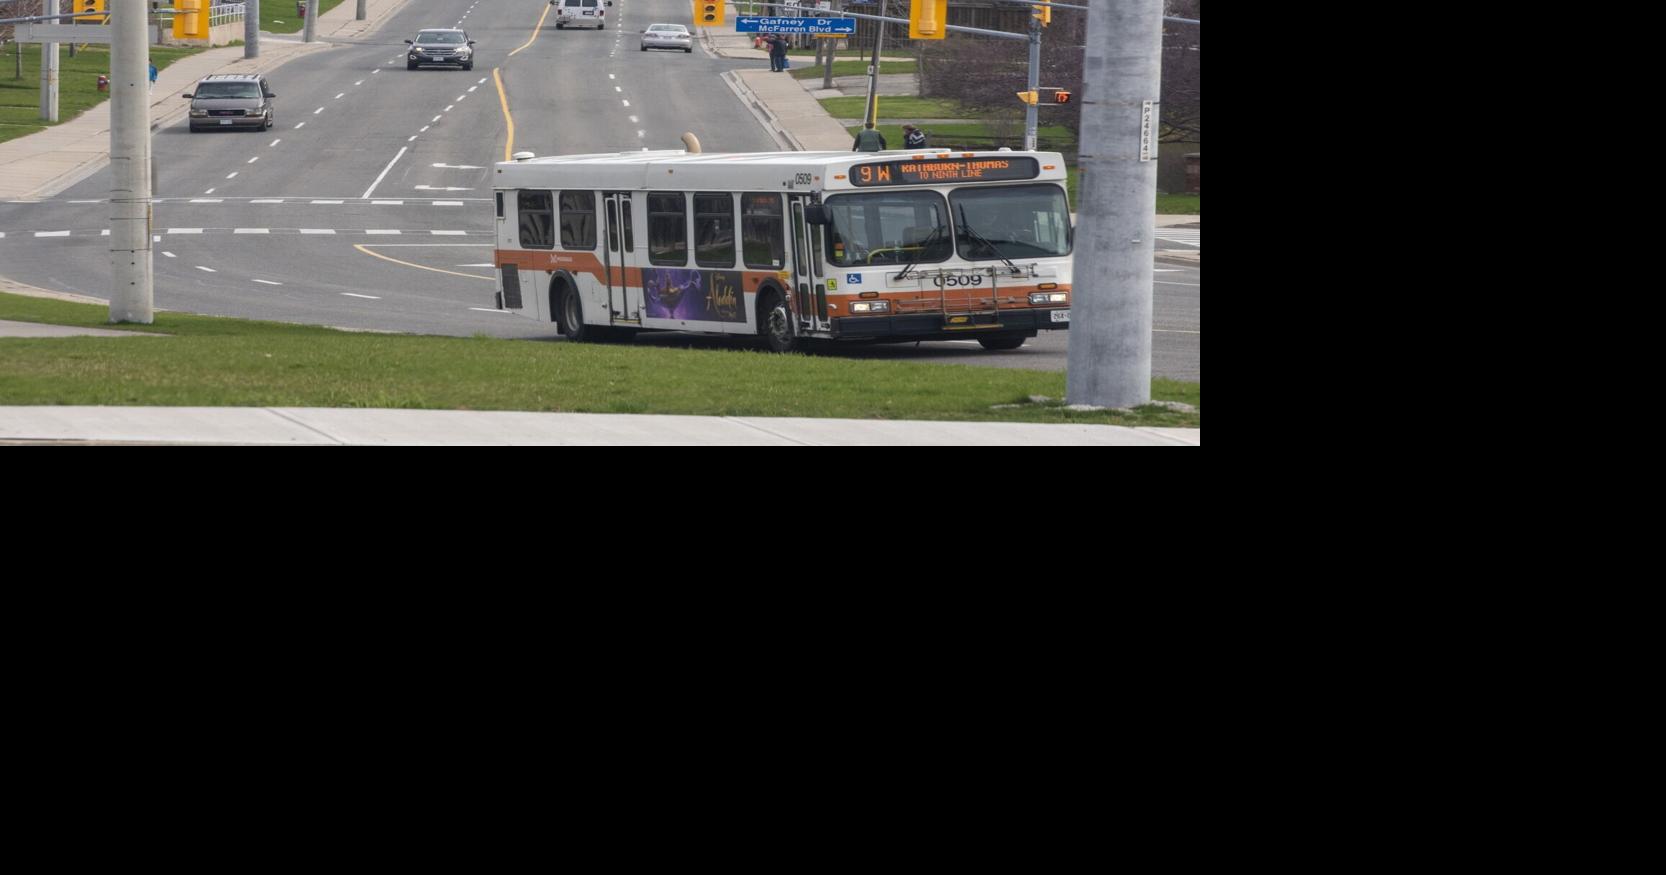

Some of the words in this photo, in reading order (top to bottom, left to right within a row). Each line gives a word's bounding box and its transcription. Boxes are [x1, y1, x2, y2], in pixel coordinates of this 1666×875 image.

[760, 18, 805, 27] Gafney
[795, 172, 812, 185] 0509
[860, 166, 872, 182] 9
[877, 165, 891, 182] W
[919, 171, 928, 180] TO
[931, 171, 958, 179] NINTH
[961, 170, 983, 178] LINE
[933, 274, 982, 287] 0509
